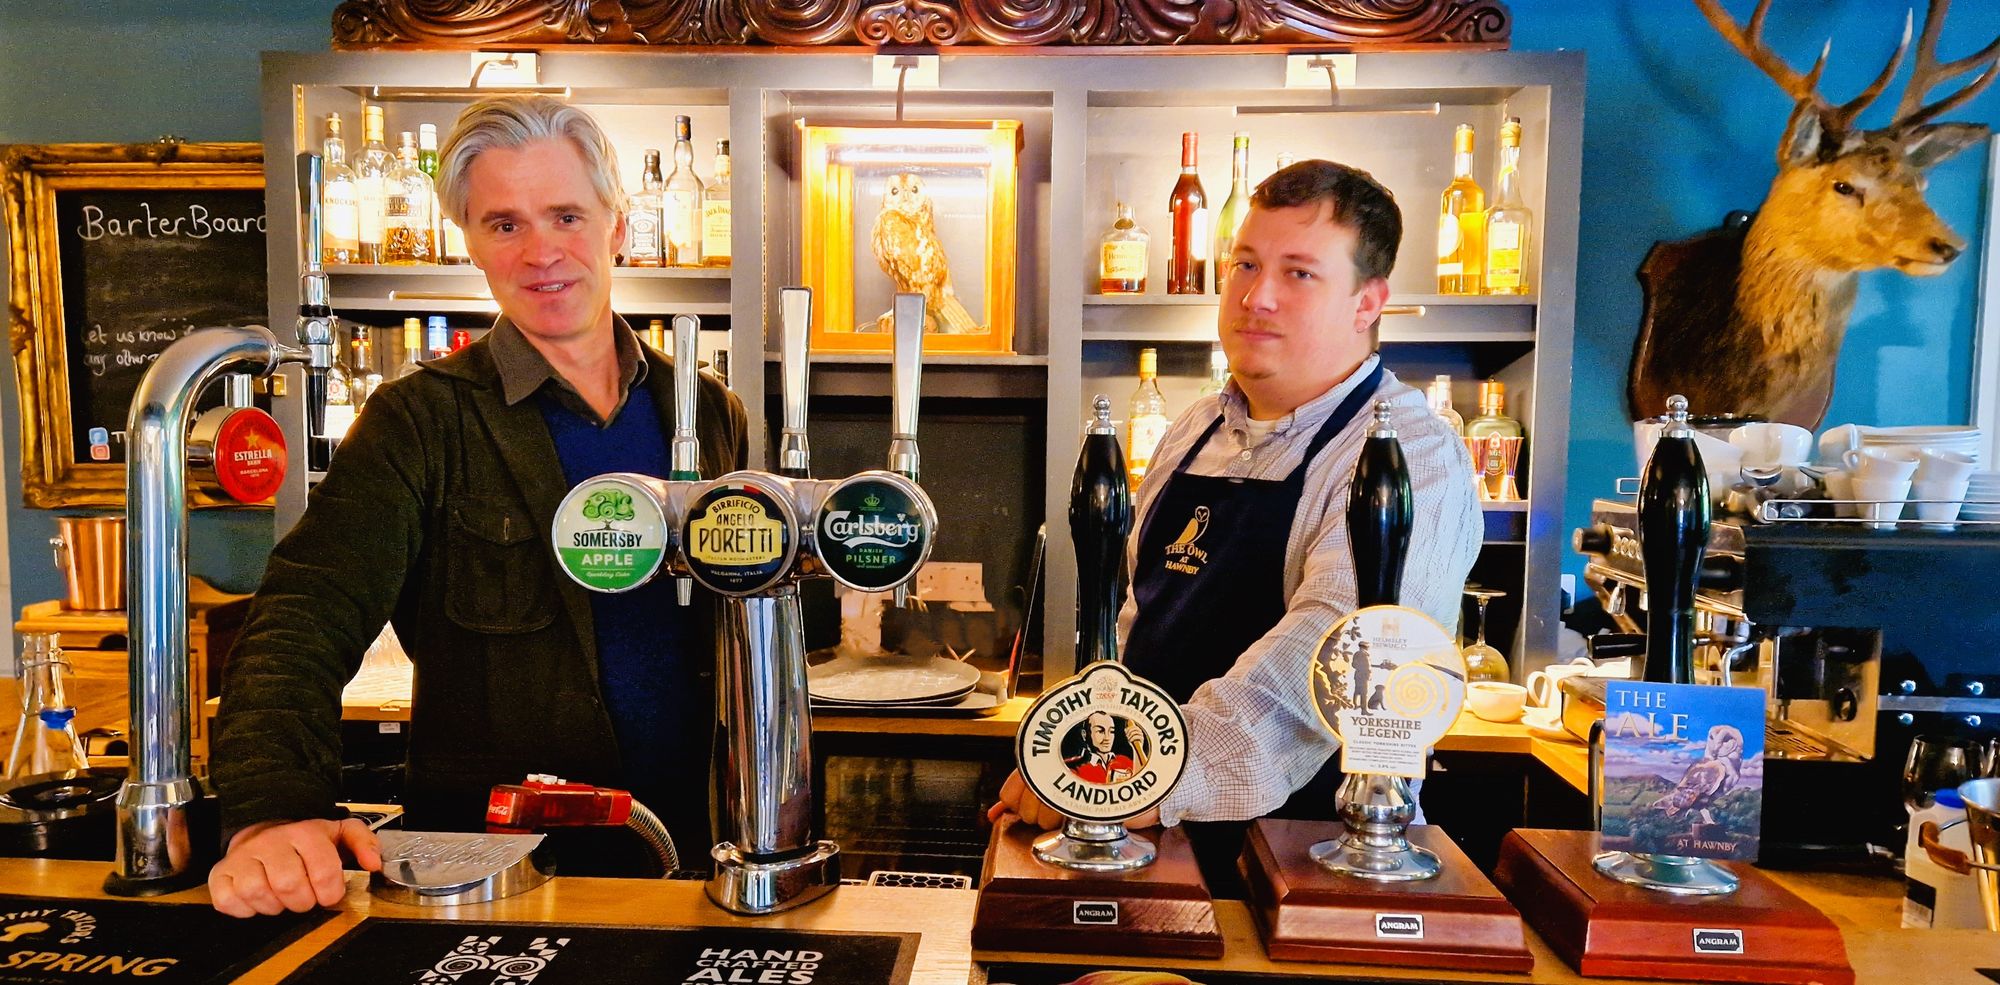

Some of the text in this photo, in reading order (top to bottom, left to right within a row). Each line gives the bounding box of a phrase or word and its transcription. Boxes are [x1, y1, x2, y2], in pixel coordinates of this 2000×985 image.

[116, 332, 135, 344] us
[139, 329, 177, 343] know
[234, 449, 272, 462] ESTRELLA
[711, 500, 761, 514] BIRRIFICIO
[716, 513, 755, 526] ANGELO
[824, 510, 921, 543] Carlsberg
[573, 532, 643, 548] SOMERSBY
[699, 528, 773, 553] PORETTI
[581, 553, 634, 566] APPLE
[845, 554, 896, 564] PILSNER
[1164, 543, 1208, 564] THE OWL
[1164, 560, 1200, 575] HAWNBY
[1615, 689, 1667, 709] THE
[1032, 687, 1180, 758] TIMOTHY TAYLOR'S
[1351, 716, 1422, 730] YORKSHIRE
[1615, 711, 1689, 741] ALE
[1359, 727, 1412, 740] LEGEND
[1052, 770, 1158, 805] LANDLORD
[1676, 839, 1738, 851] AT HAWNBY
[1380, 921, 1419, 930] ANGRAM
[1698, 937, 1738, 946] ANGRAM
[700, 948, 824, 962] HAND
[0, 950, 179, 976] SPRING
[696, 959, 819, 970] CRAFTED
[685, 967, 815, 985] ALES
